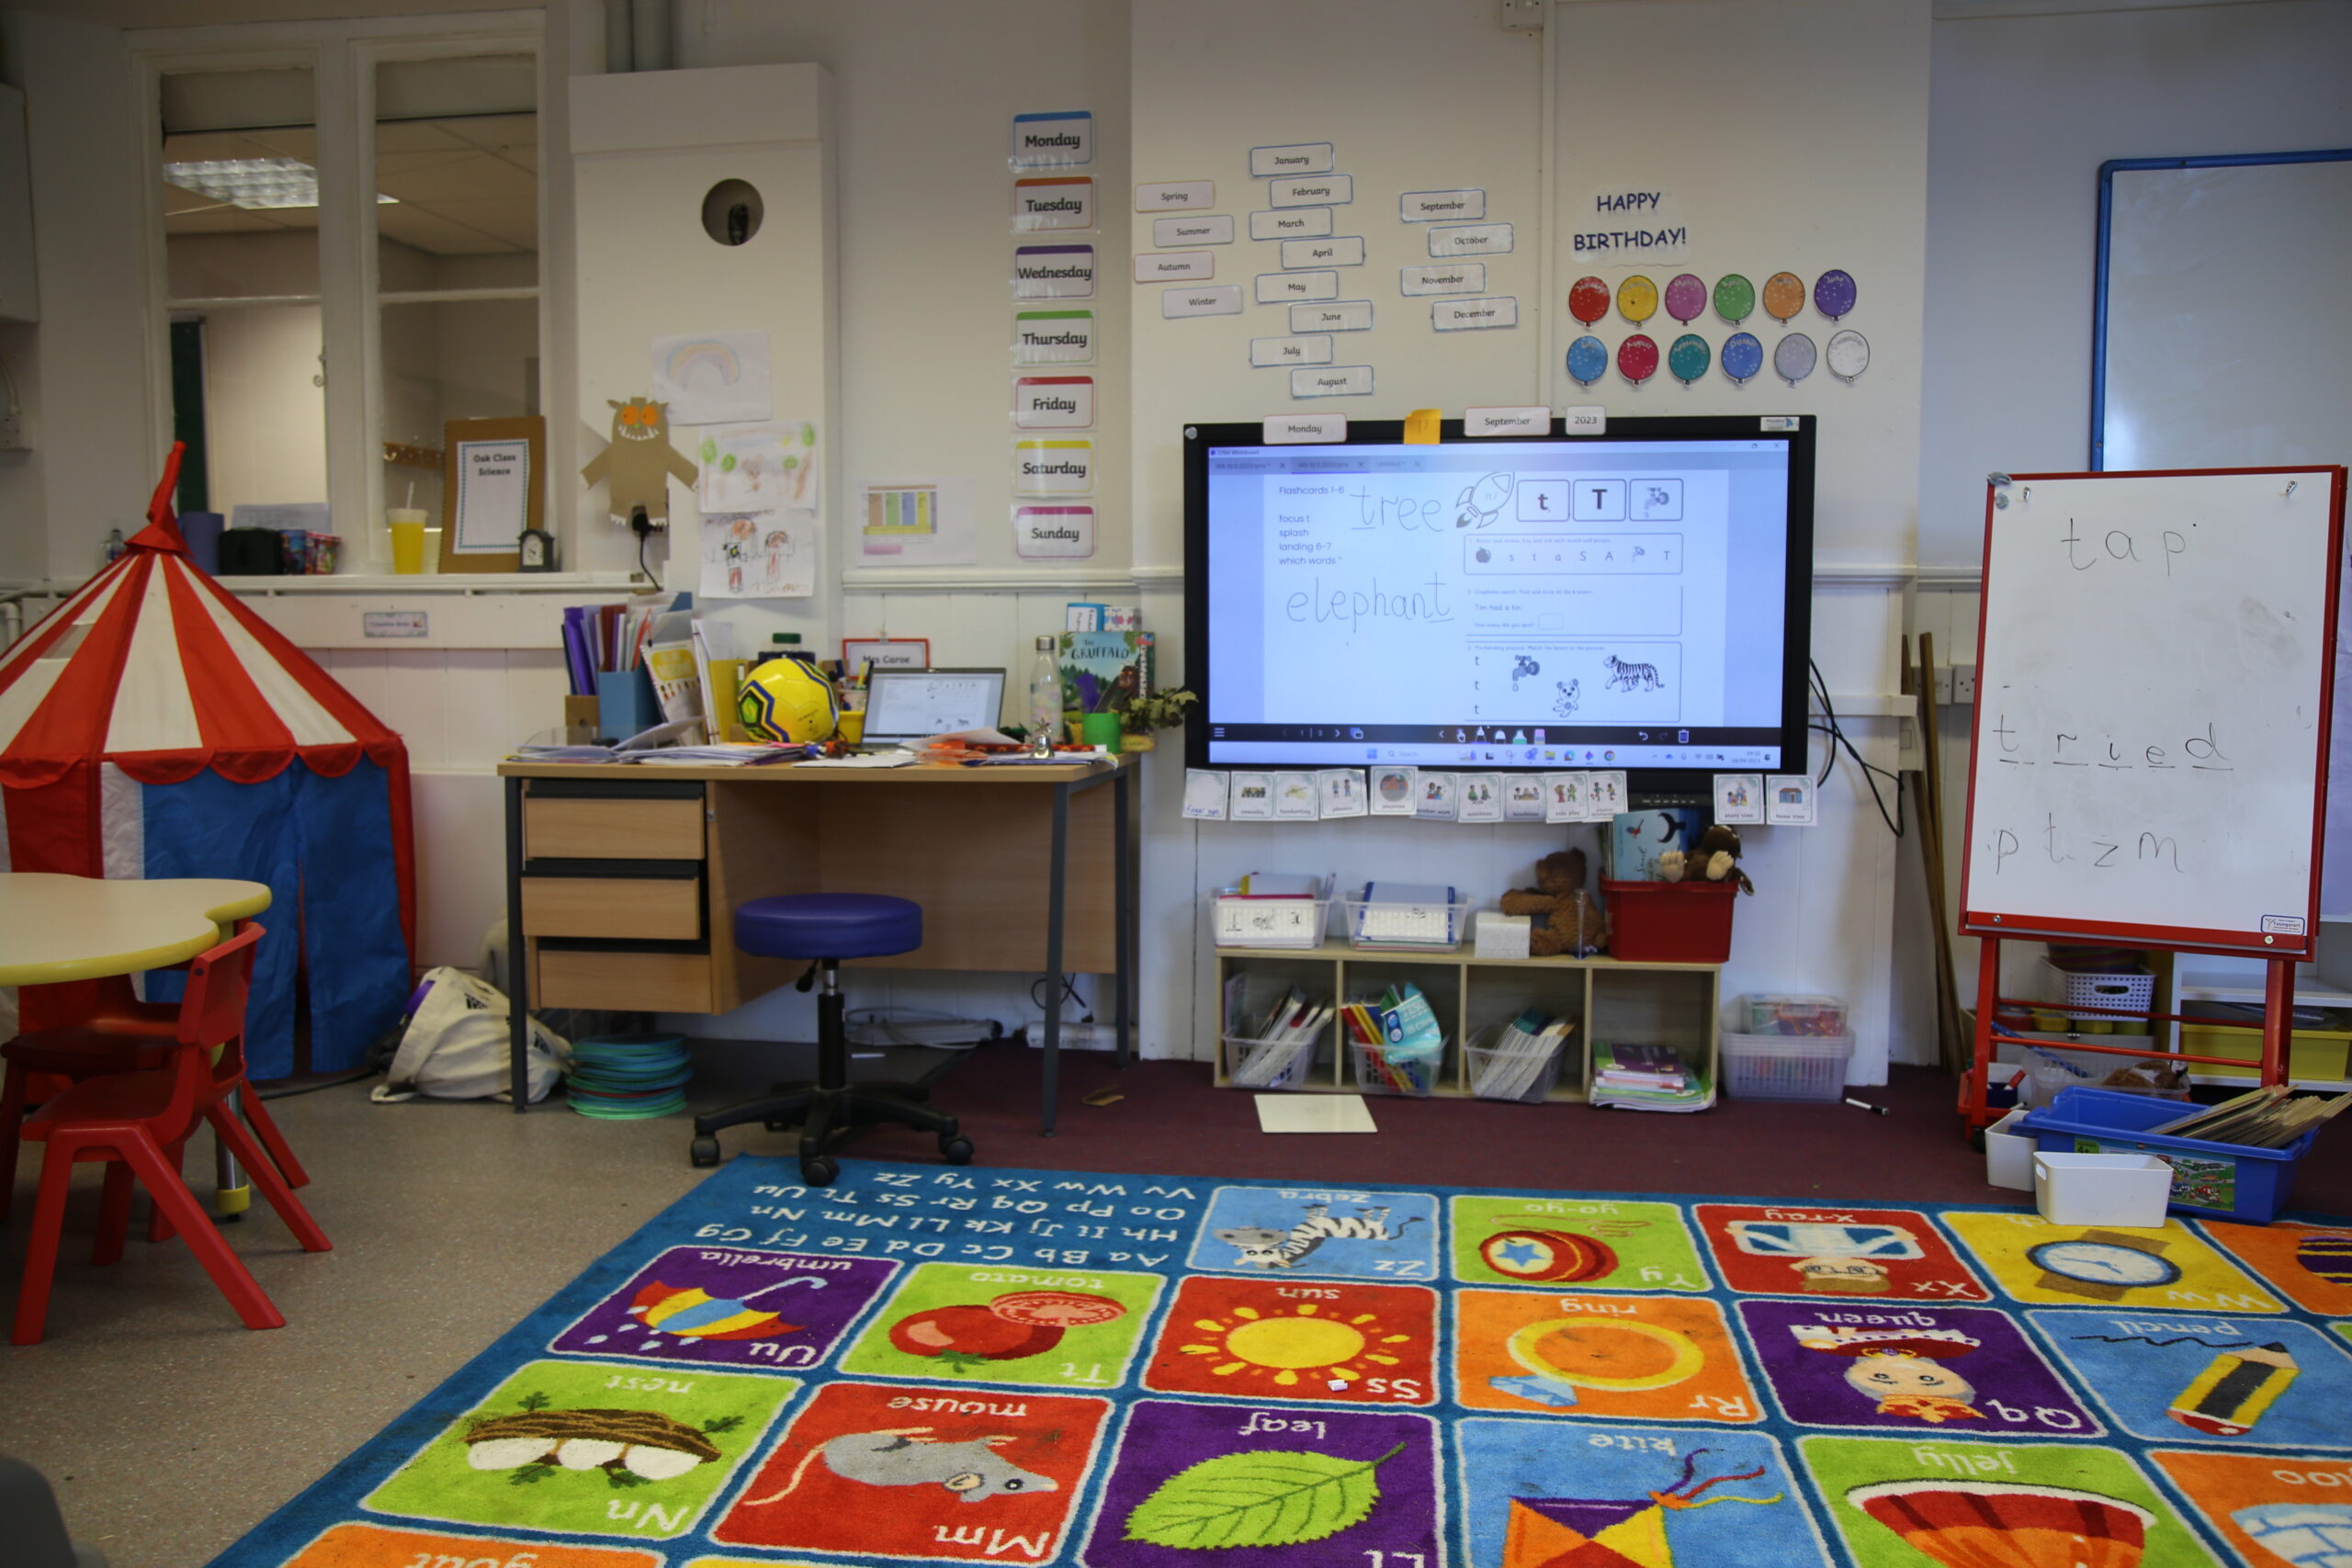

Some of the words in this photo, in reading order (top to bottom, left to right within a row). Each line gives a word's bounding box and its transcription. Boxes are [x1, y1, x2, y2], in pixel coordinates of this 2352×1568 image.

[1024, 131, 1080, 150] Monday
[1273, 154, 1310, 166] January
[1160, 191, 1189, 203] Spring
[1292, 186, 1330, 197] February
[1025, 197, 1082, 215] Tuesday
[1420, 200, 1465, 213] September
[1597, 192, 1661, 212] HAPPY
[1176, 227, 1211, 235] Summer
[1277, 219, 1305, 229] March
[1453, 235, 1488, 244] October
[1573, 227, 1687, 252] BIRTHDAY!
[1312, 247, 1334, 258] April
[1017, 265, 1092, 282] Wednesday
[1158, 262, 1191, 272] Autumn
[1287, 282, 1306, 293] May
[1421, 275, 1464, 285] November
[1188, 297, 1217, 306] Winter
[1320, 311, 1342, 321] June
[1453, 309, 1496, 320] December
[1022, 331, 1088, 349] Thursday
[1282, 345, 1301, 356] July
[1317, 377, 1348, 388] August
[1033, 396, 1077, 413] Friday
[1287, 423, 1323, 434] Monday
[1484, 416, 1532, 427] September
[1574, 416, 1598, 424] 2023
[473, 454, 491, 462] Oak
[492, 453, 516, 462] Class
[478, 468, 510, 476] Science
[1023, 461, 1086, 479] Saturday
[1279, 486, 1329, 495] Flashcards
[1538, 493, 1549, 511] t
[1592, 489, 1608, 510] T
[1351, 485, 1444, 533] tree
[1279, 514, 1305, 523] focus
[1031, 527, 1080, 542] Sunday
[1279, 528, 1308, 538] splash
[1279, 542, 1314, 552] landing
[1317, 542, 1332, 550] 6-7
[1279, 557, 1306, 565] which
[1308, 557, 1336, 565] words
[1605, 551, 1613, 560] A
[1663, 551, 1670, 560] T
[1286, 572, 1453, 636] elephant
[1071, 647, 1129, 660] GRUFFALO
[1475, 656, 1479, 666] t
[1475, 681, 1479, 691] t
[1475, 705, 1479, 715] t
[874, 1172, 922, 1187] Zz
[933, 1173, 976, 1190] Yy
[991, 1179, 1042, 1191] Xx
[753, 1185, 808, 1199] Uu
[822, 1188, 859, 1204] Tt
[1053, 1181, 1126, 1195] Ww
[1143, 1186, 1195, 1200] Vv
[876, 1193, 921, 1207] Ss
[929, 1197, 978, 1211] Rr
[992, 1196, 1048, 1213] Qq
[1277, 1190, 1372, 1204] zebra
[751, 1205, 807, 1221] Nn
[1066, 1201, 1114, 1217] Pp
[1130, 1206, 1186, 1220] Oo
[1524, 1201, 1620, 1216] yo-yo
[1763, 1209, 1857, 1224] x-ray
[820, 1211, 900, 1227] Mm
[909, 1216, 950, 1233] Ll
[965, 1219, 1014, 1234] Kk
[695, 1224, 752, 1241] Gg
[1029, 1218, 1063, 1237] Jj
[1078, 1225, 1110, 1239] Ii
[1122, 1227, 1177, 1242] Hh
[759, 1228, 808, 1247] Ff
[822, 1236, 868, 1252] Ee
[883, 1240, 944, 1257] Dd
[961, 1244, 1014, 1260] Cc
[1035, 1248, 1090, 1265] Bb
[700, 1251, 853, 1270] umbrella
[1109, 1251, 1169, 1268] Aa
[1374, 1260, 1427, 1277] Zz
[969, 1272, 1104, 1289] tomato
[1639, 1267, 1699, 1288] Yy
[1277, 1287, 1342, 1300] sun
[1909, 1279, 1973, 1299] Xx
[2165, 1288, 2274, 1310] Ww
[1560, 1299, 1639, 1316] ring
[1815, 1310, 1937, 1328] queen
[2111, 1319, 2243, 1337] pencil
[749, 1342, 818, 1365] Uu
[1058, 1362, 1109, 1384] Tt
[604, 1374, 696, 1394] nest
[1365, 1377, 1422, 1401] Ss
[886, 1394, 1028, 1419] mouse
[1688, 1394, 1747, 1417] Rr
[1984, 1398, 2084, 1430] Qq
[1237, 1412, 1327, 1440] leaf
[1589, 1433, 1677, 1457] kite
[1911, 1446, 2017, 1475] jelly
[606, 1499, 690, 1532] Nn
[933, 1524, 1050, 1559] Mm
